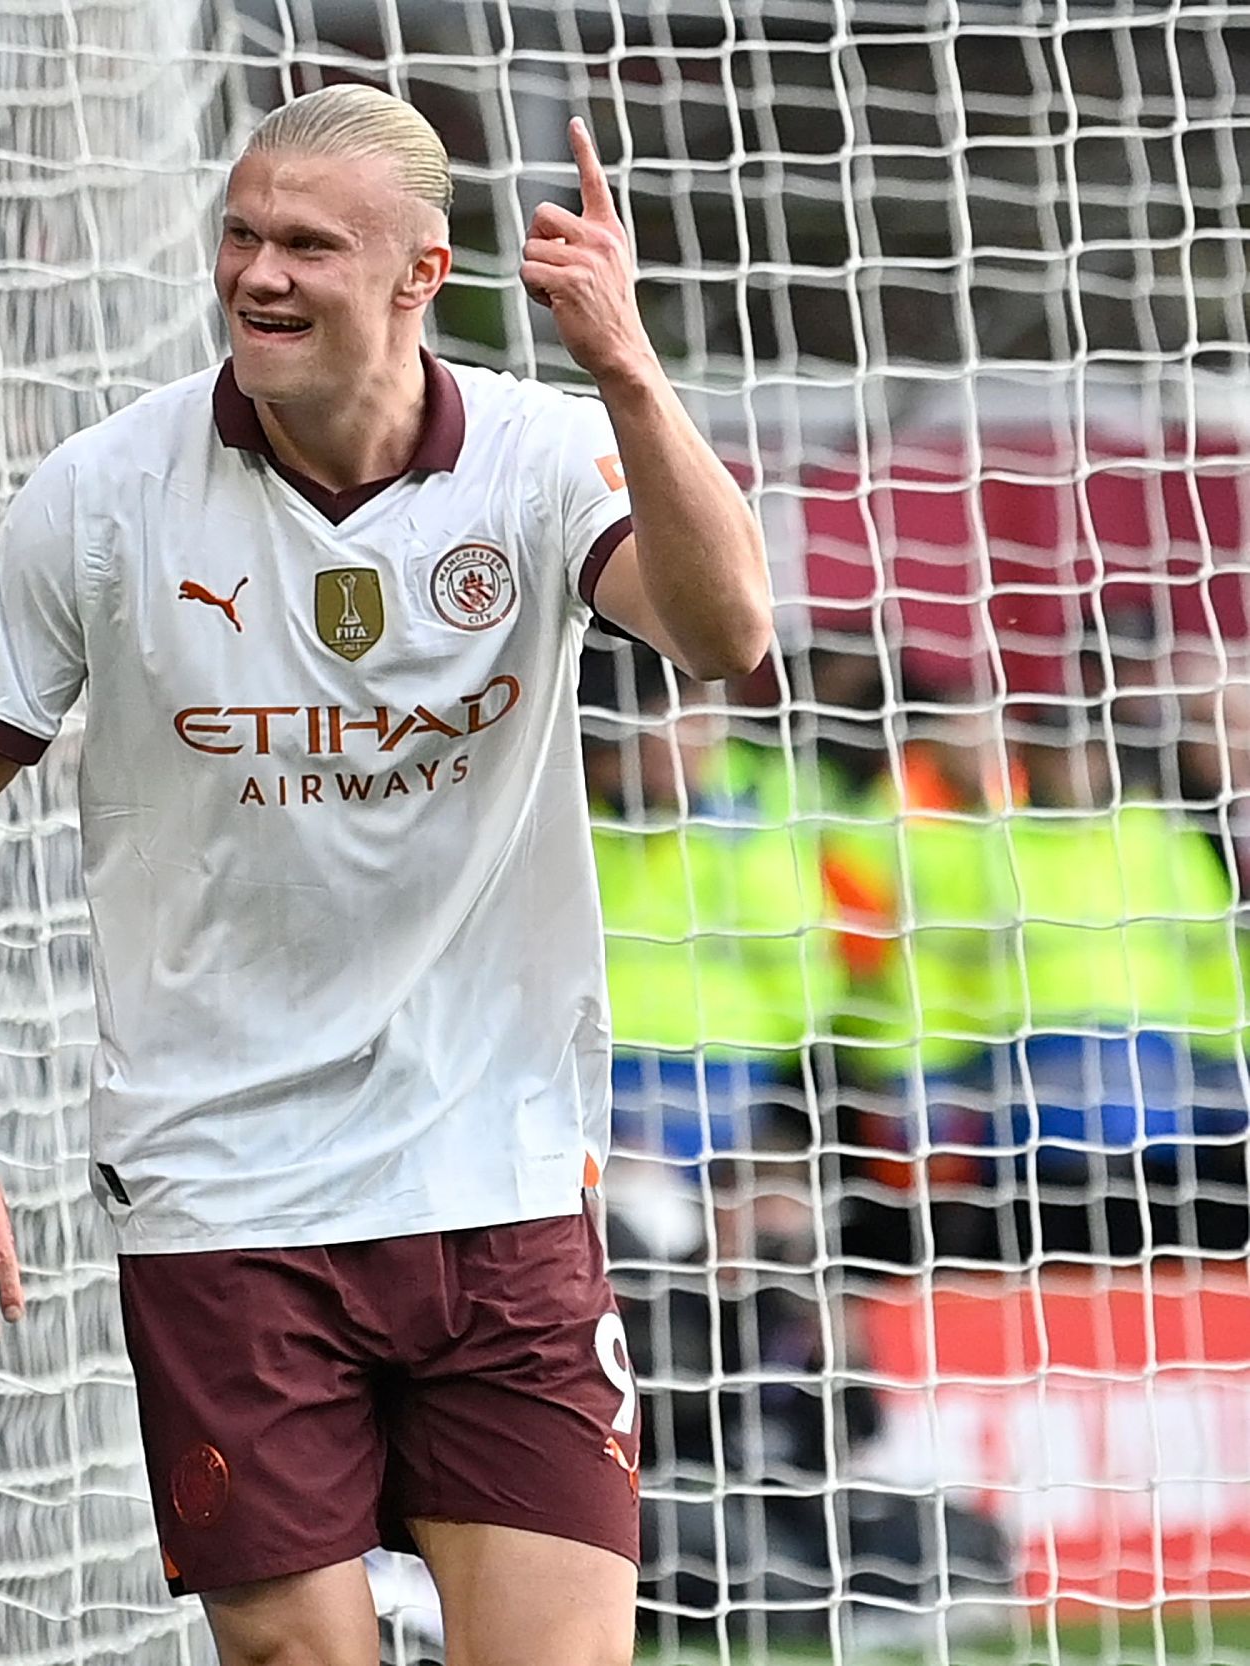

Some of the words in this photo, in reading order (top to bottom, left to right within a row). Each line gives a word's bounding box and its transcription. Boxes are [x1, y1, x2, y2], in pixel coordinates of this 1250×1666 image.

[439, 550, 503, 582] MANCHESTER
[336, 626, 367, 640] FIFA
[468, 613, 492, 624] CITY
[173, 674, 521, 755] ETIHAD
[239, 755, 470, 807] AIRWAYS
[594, 1312, 636, 1435] 9
